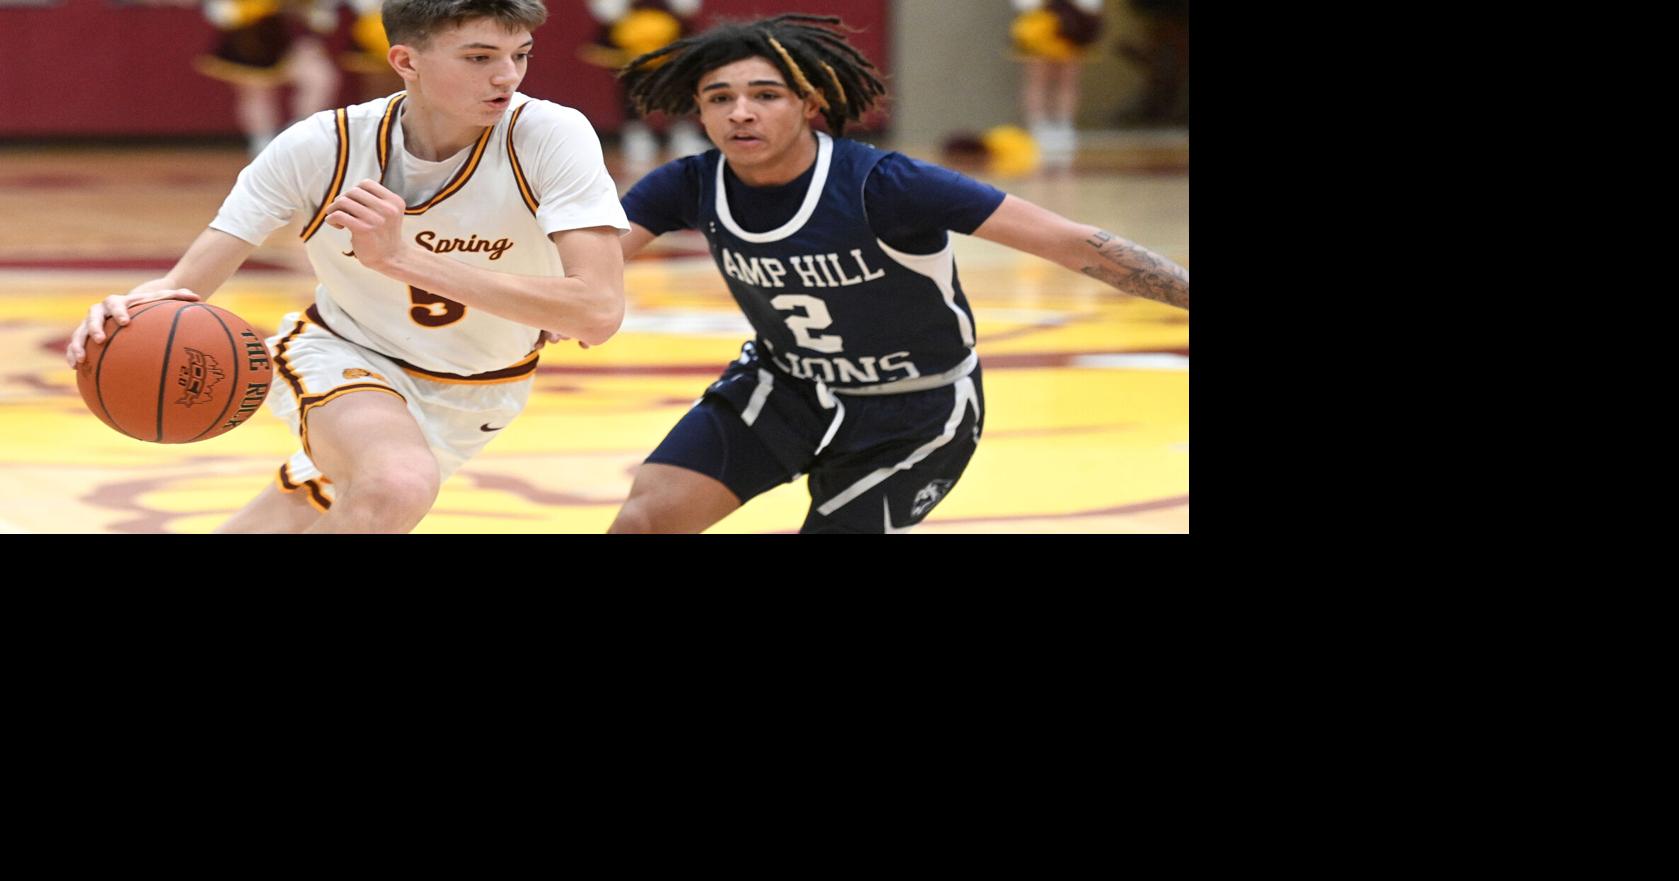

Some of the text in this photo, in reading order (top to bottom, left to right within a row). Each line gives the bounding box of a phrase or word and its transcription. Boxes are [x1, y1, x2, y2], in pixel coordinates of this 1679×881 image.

[722, 248, 885, 287] AMP HILL
[769, 294, 844, 353] 2
[241, 328, 270, 371] THE
